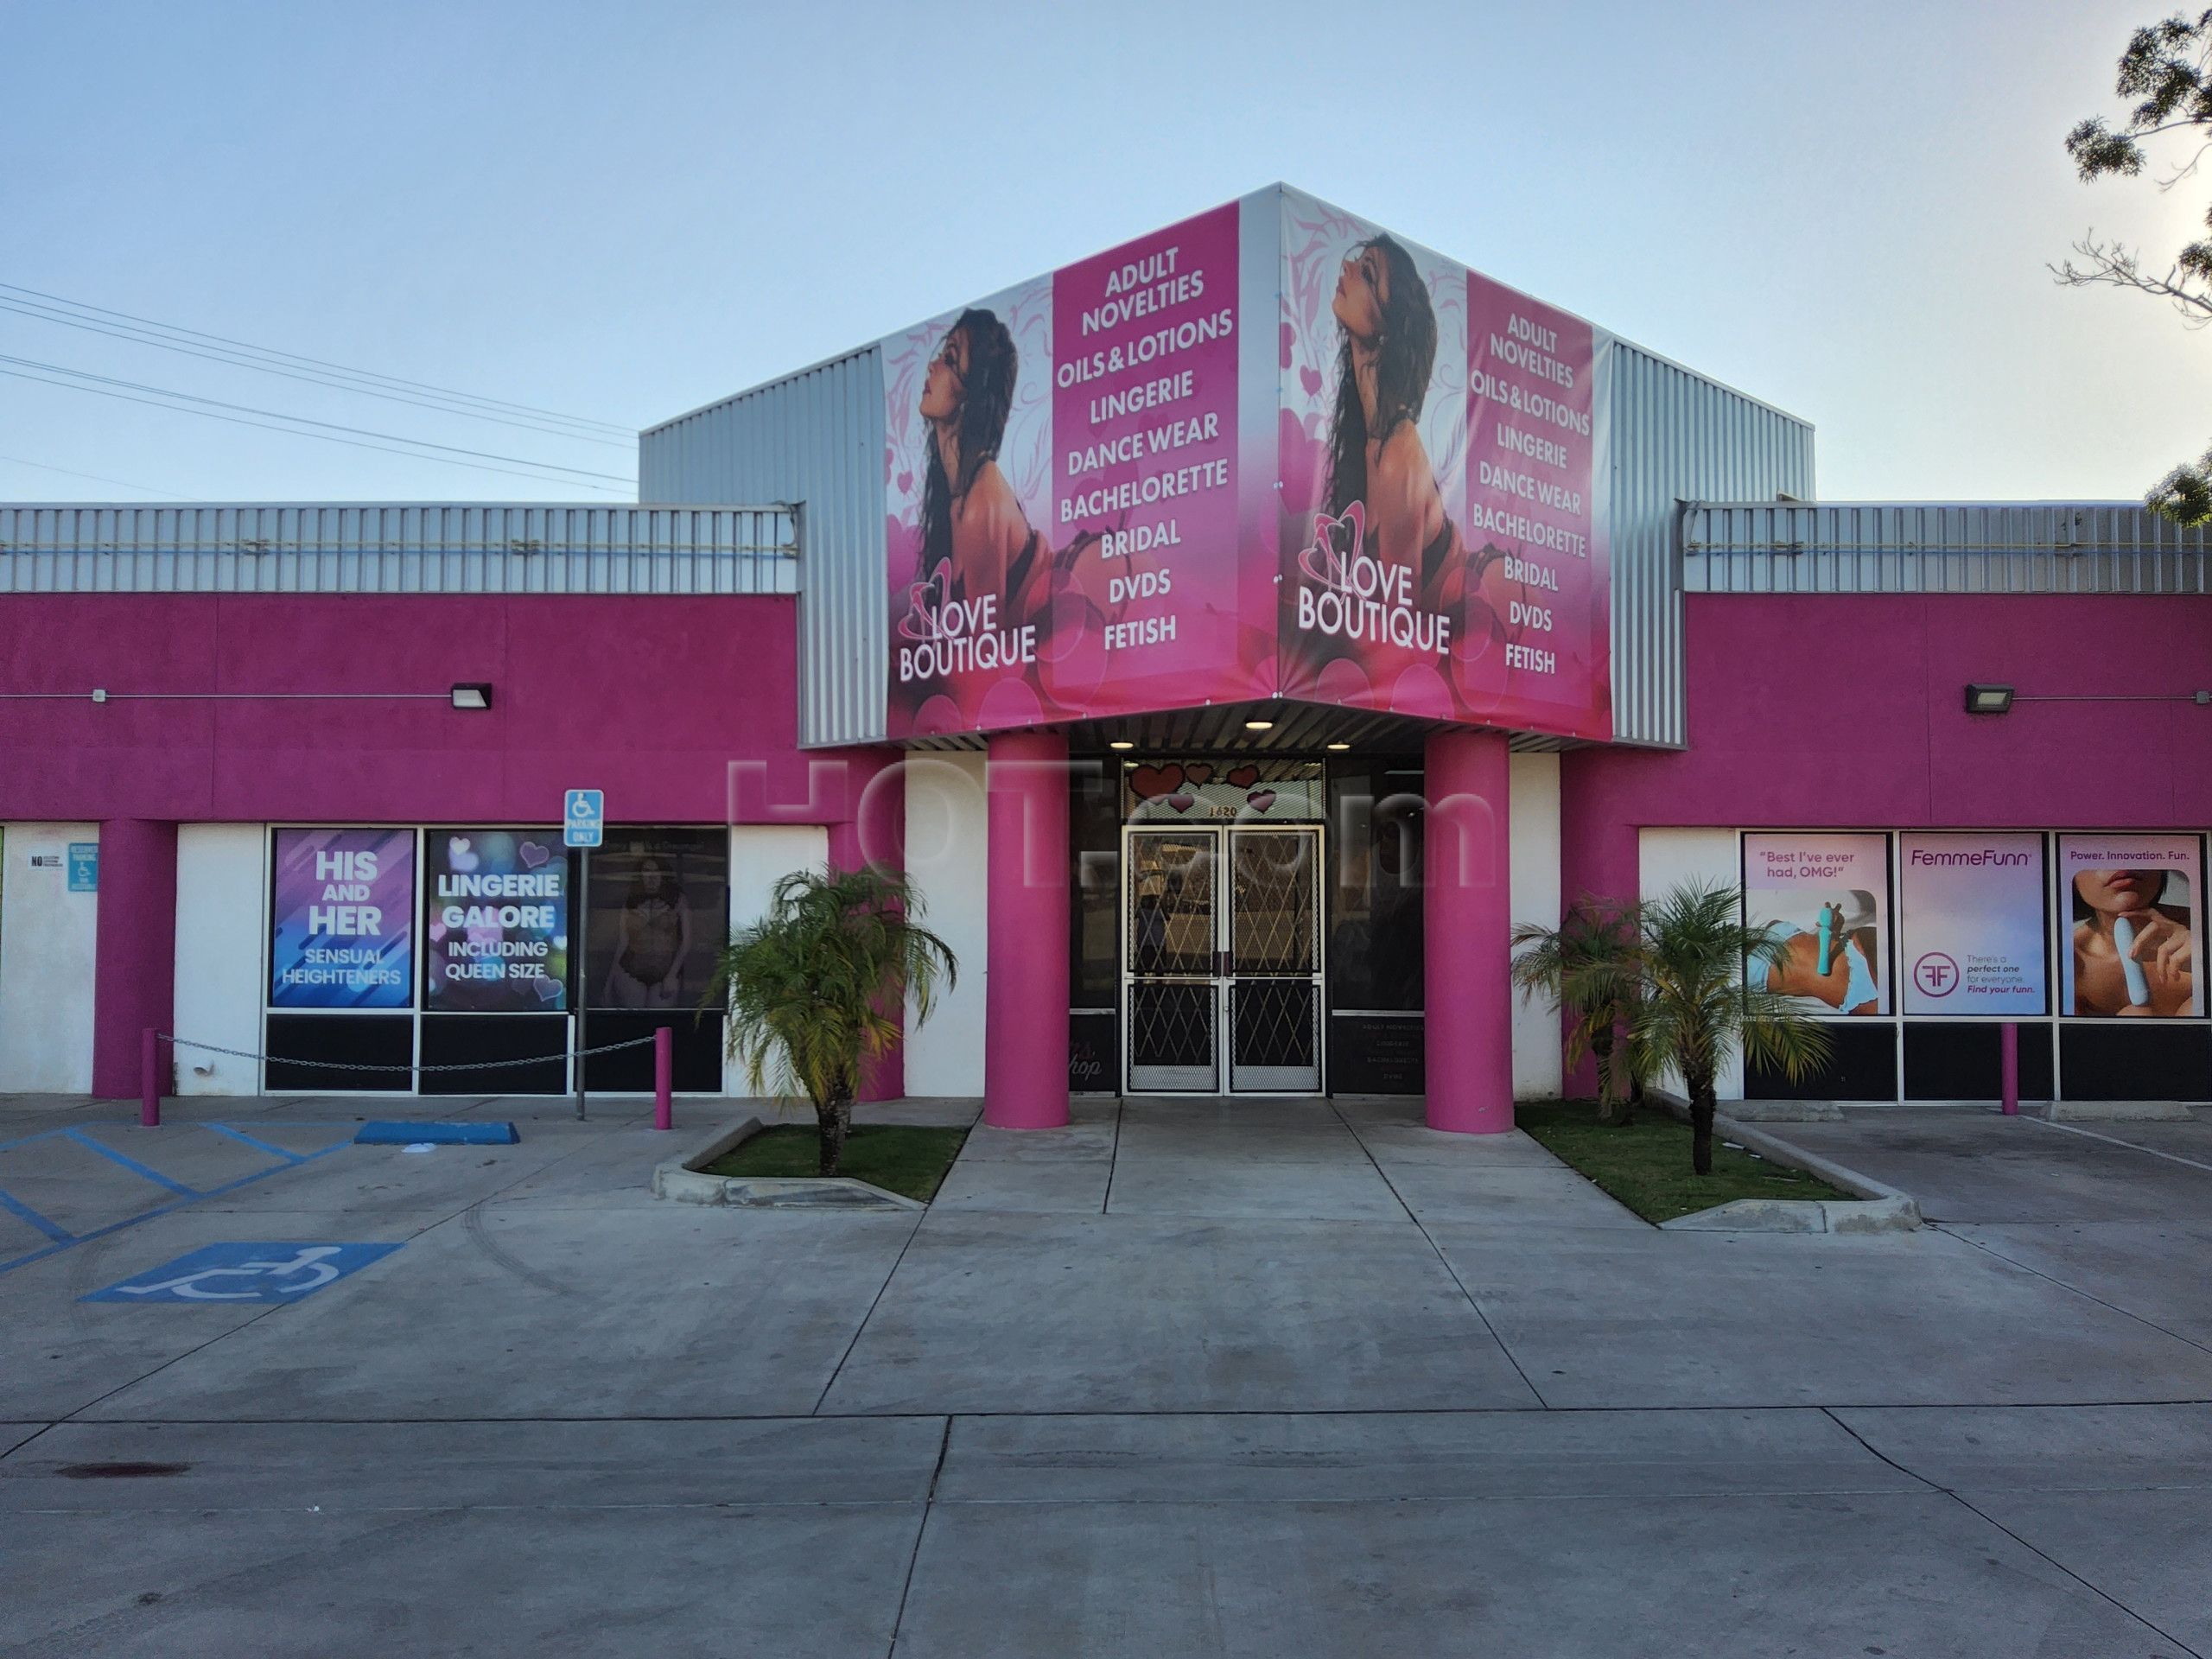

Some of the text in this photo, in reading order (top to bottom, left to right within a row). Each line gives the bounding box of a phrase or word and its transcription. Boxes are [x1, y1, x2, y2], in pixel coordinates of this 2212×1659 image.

[1104, 246, 1179, 297] ADULT
[1081, 270, 1205, 336] NOVELTIES
[1057, 308, 1233, 389] OILS & LOTIONS
[1507, 313, 1557, 354] ADULT
[1491, 334, 1573, 389] NOVELTIES
[1090, 370, 1193, 425] LINGERIE
[1471, 369, 1590, 435] OILS & LOTIONS
[1068, 411, 1218, 476] DANCE WEAR
[1497, 423, 1567, 469] LINGERIE
[1061, 459, 1228, 523] BACHELORETTE
[1479, 461, 1581, 516] DANCE WEAR
[1101, 518, 1181, 560] BRIDAL
[1473, 503, 1586, 558] BACHELORETTE
[1109, 569, 1172, 604] DVDS
[1341, 551, 1414, 606] LOVE
[1503, 556, 1559, 592] BRIDAL
[931, 594, 997, 640] LOVE
[1104, 614, 1176, 651] FETISH
[1298, 586, 1451, 655] BOUTIQUE
[1510, 601, 1553, 632] DVDS
[899, 625, 1036, 682] BOUTIQUE
[1505, 643, 1556, 676] FETISH
[1210, 806, 1236, 817] 1620
[572, 831, 594, 842] ONLY
[31, 855, 42, 867] NO
[315, 850, 378, 881] HIS
[1799, 851, 1822, 862] I've
[1826, 854, 1855, 862] ever
[2070, 851, 2190, 860] Power. Innovation. Fun.
[438, 874, 560, 898] LINGERIE
[1767, 867, 1796, 880] had,
[321, 884, 371, 902] AND
[308, 906, 382, 936] HER
[442, 905, 555, 929] GALORE
[304, 948, 385, 965] SENSUAL
[448, 940, 549, 958] INCLUDING
[1967, 954, 1998, 963] There's
[282, 969, 402, 986] HEIGHTENERS
[445, 962, 545, 981] QUEEN SIZE
[1967, 964, 2001, 975] perfect
[1981, 976, 2025, 985] everyone.
[1967, 985, 2036, 995] Find your funn.
[1069, 1052, 1103, 1082] hop
